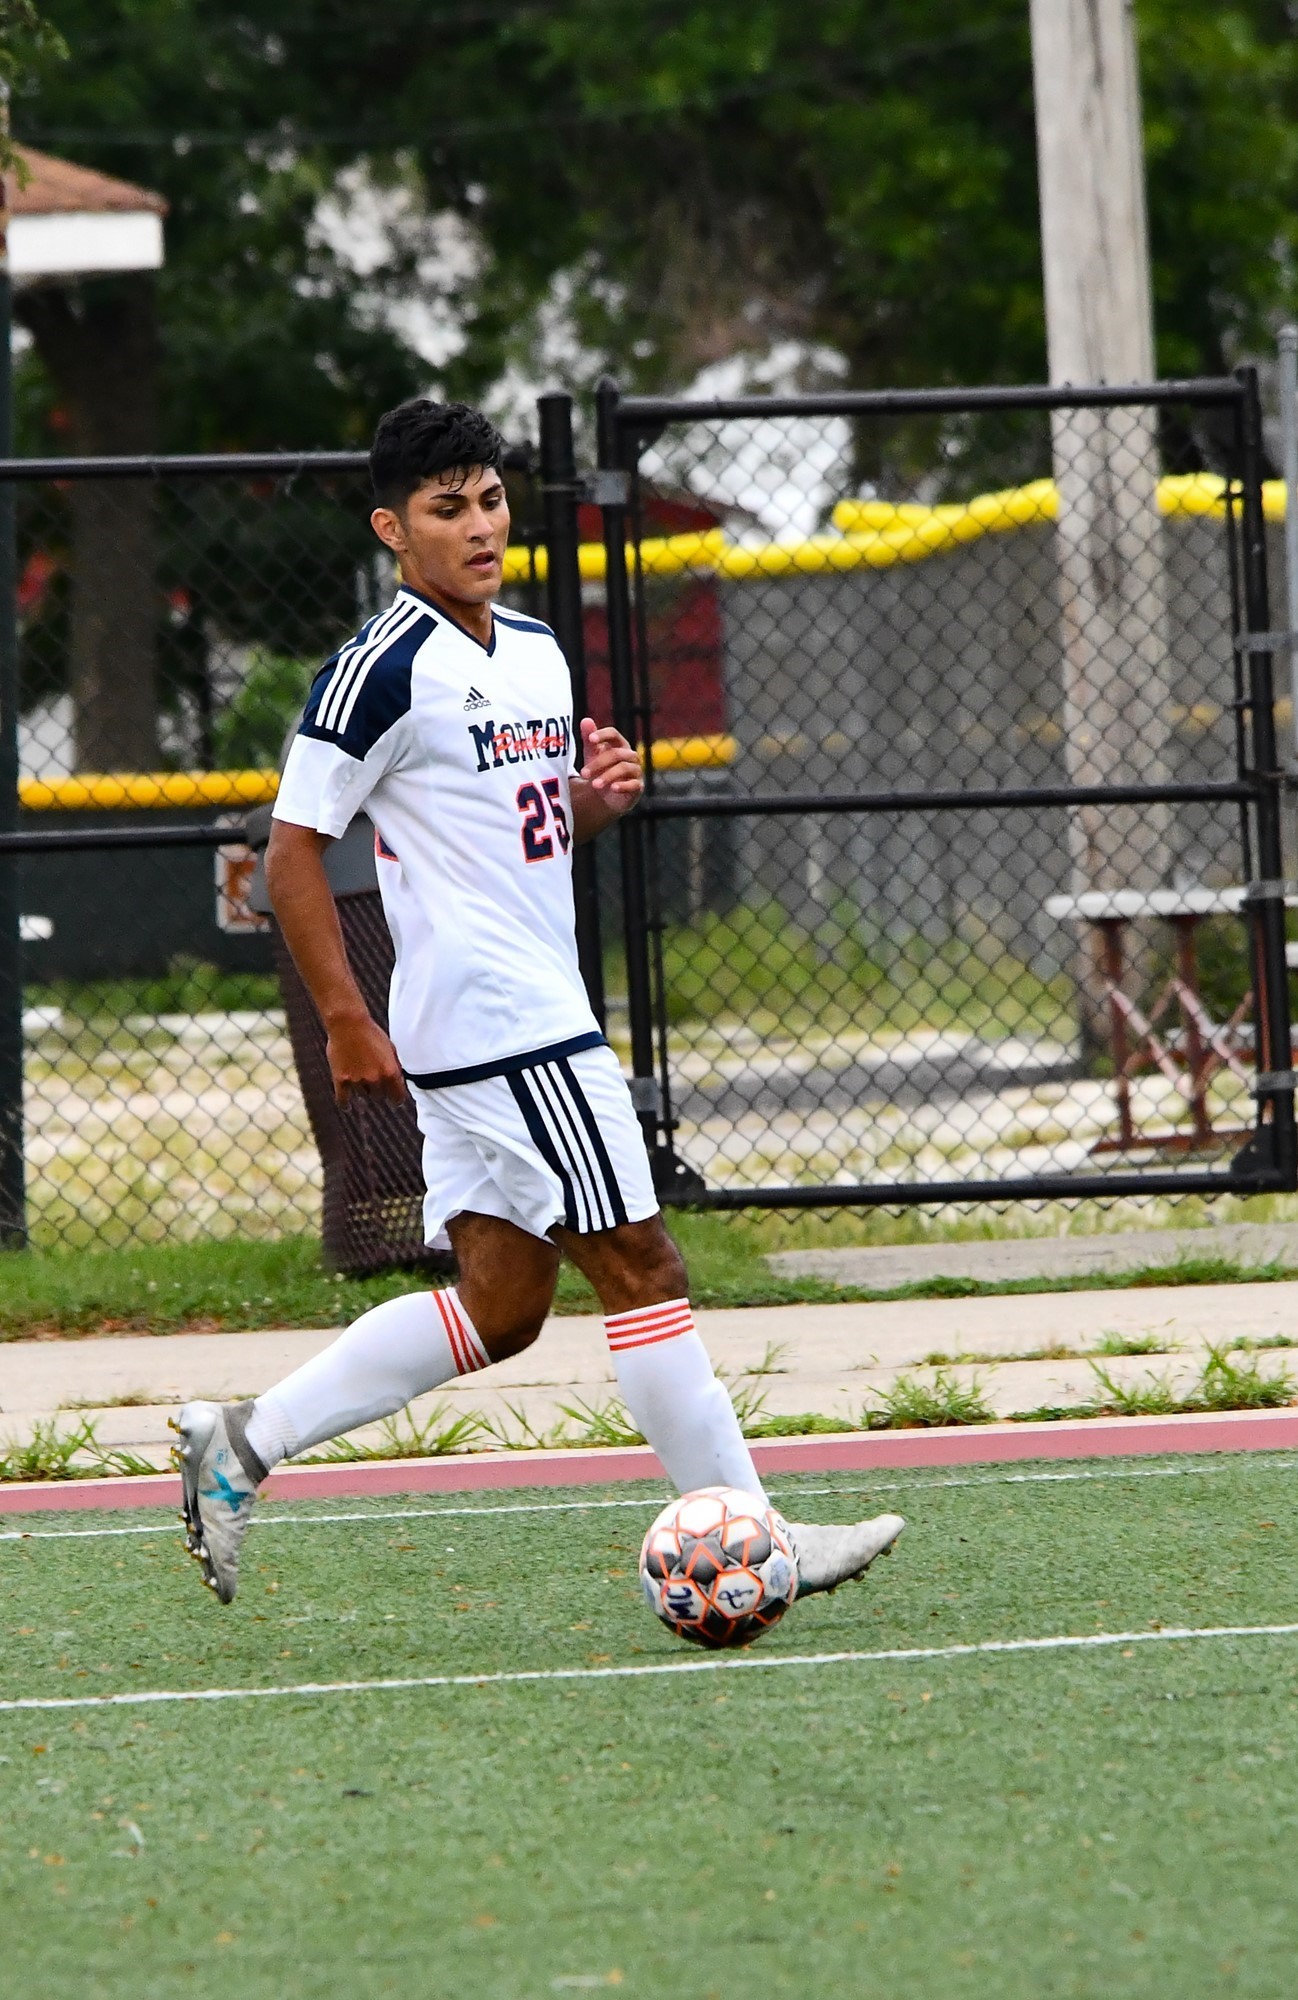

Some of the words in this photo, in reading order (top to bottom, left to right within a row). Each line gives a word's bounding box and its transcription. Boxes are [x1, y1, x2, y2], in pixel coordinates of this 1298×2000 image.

[463, 699, 492, 712] adidas
[468, 715, 571, 773] MORTON
[516, 777, 571, 864] 25
